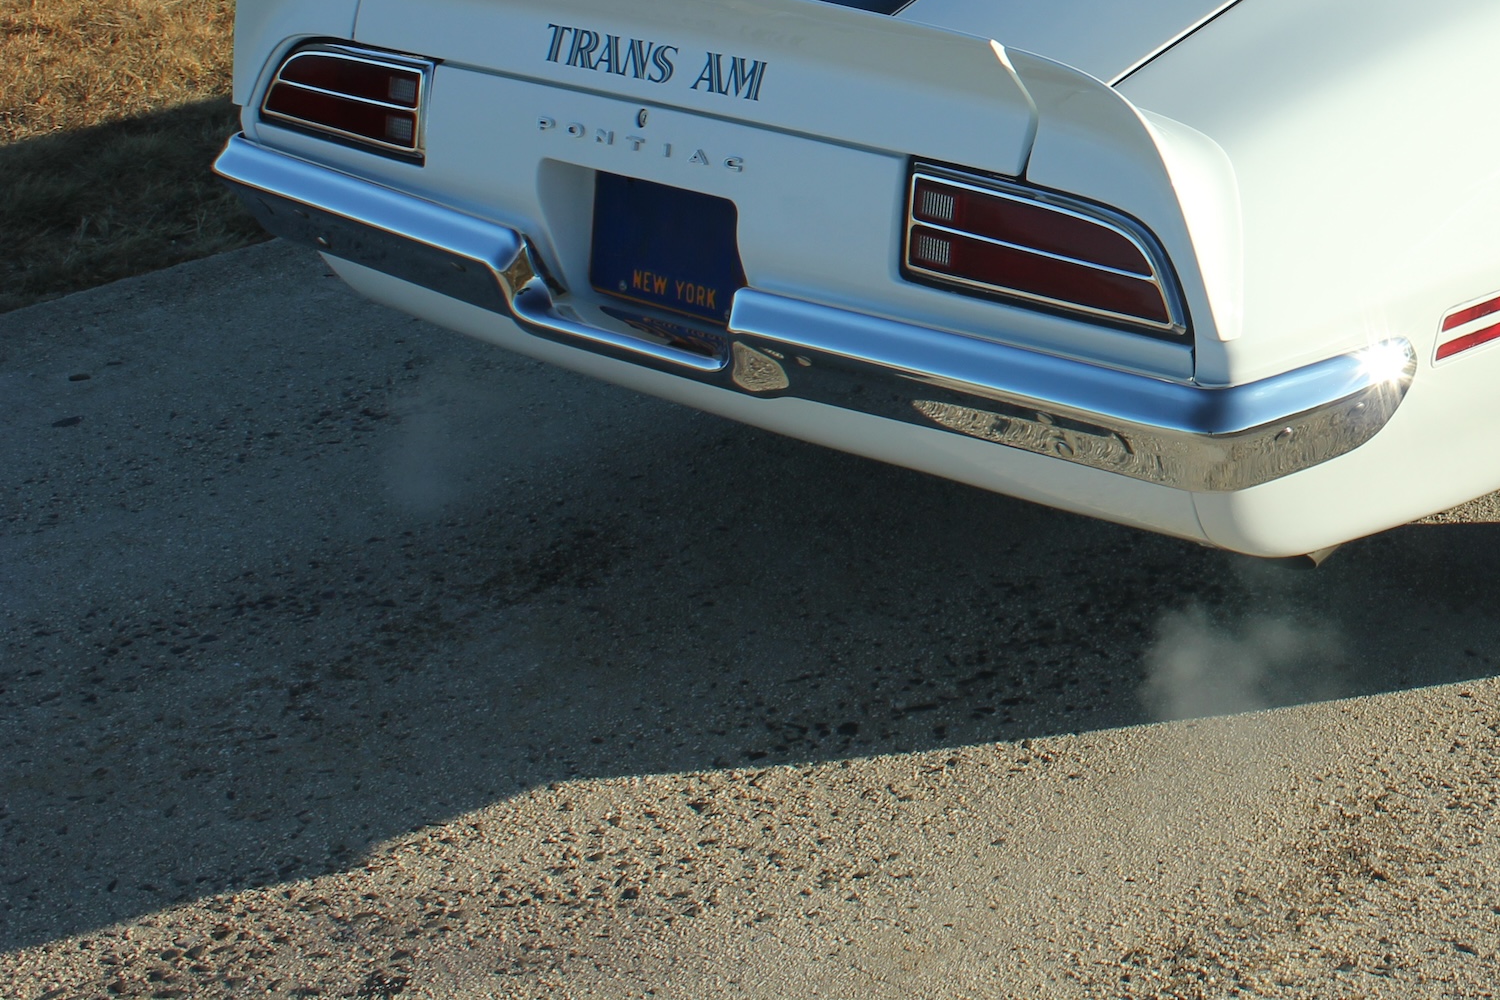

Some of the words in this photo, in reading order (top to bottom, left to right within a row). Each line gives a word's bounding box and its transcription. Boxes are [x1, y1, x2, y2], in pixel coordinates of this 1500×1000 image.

[546, 22, 679, 84] TRANS
[689, 51, 768, 101] AM
[536, 115, 744, 173] PONTIAC
[632, 268, 668, 296] NEW
[675, 280, 717, 310] YORK
